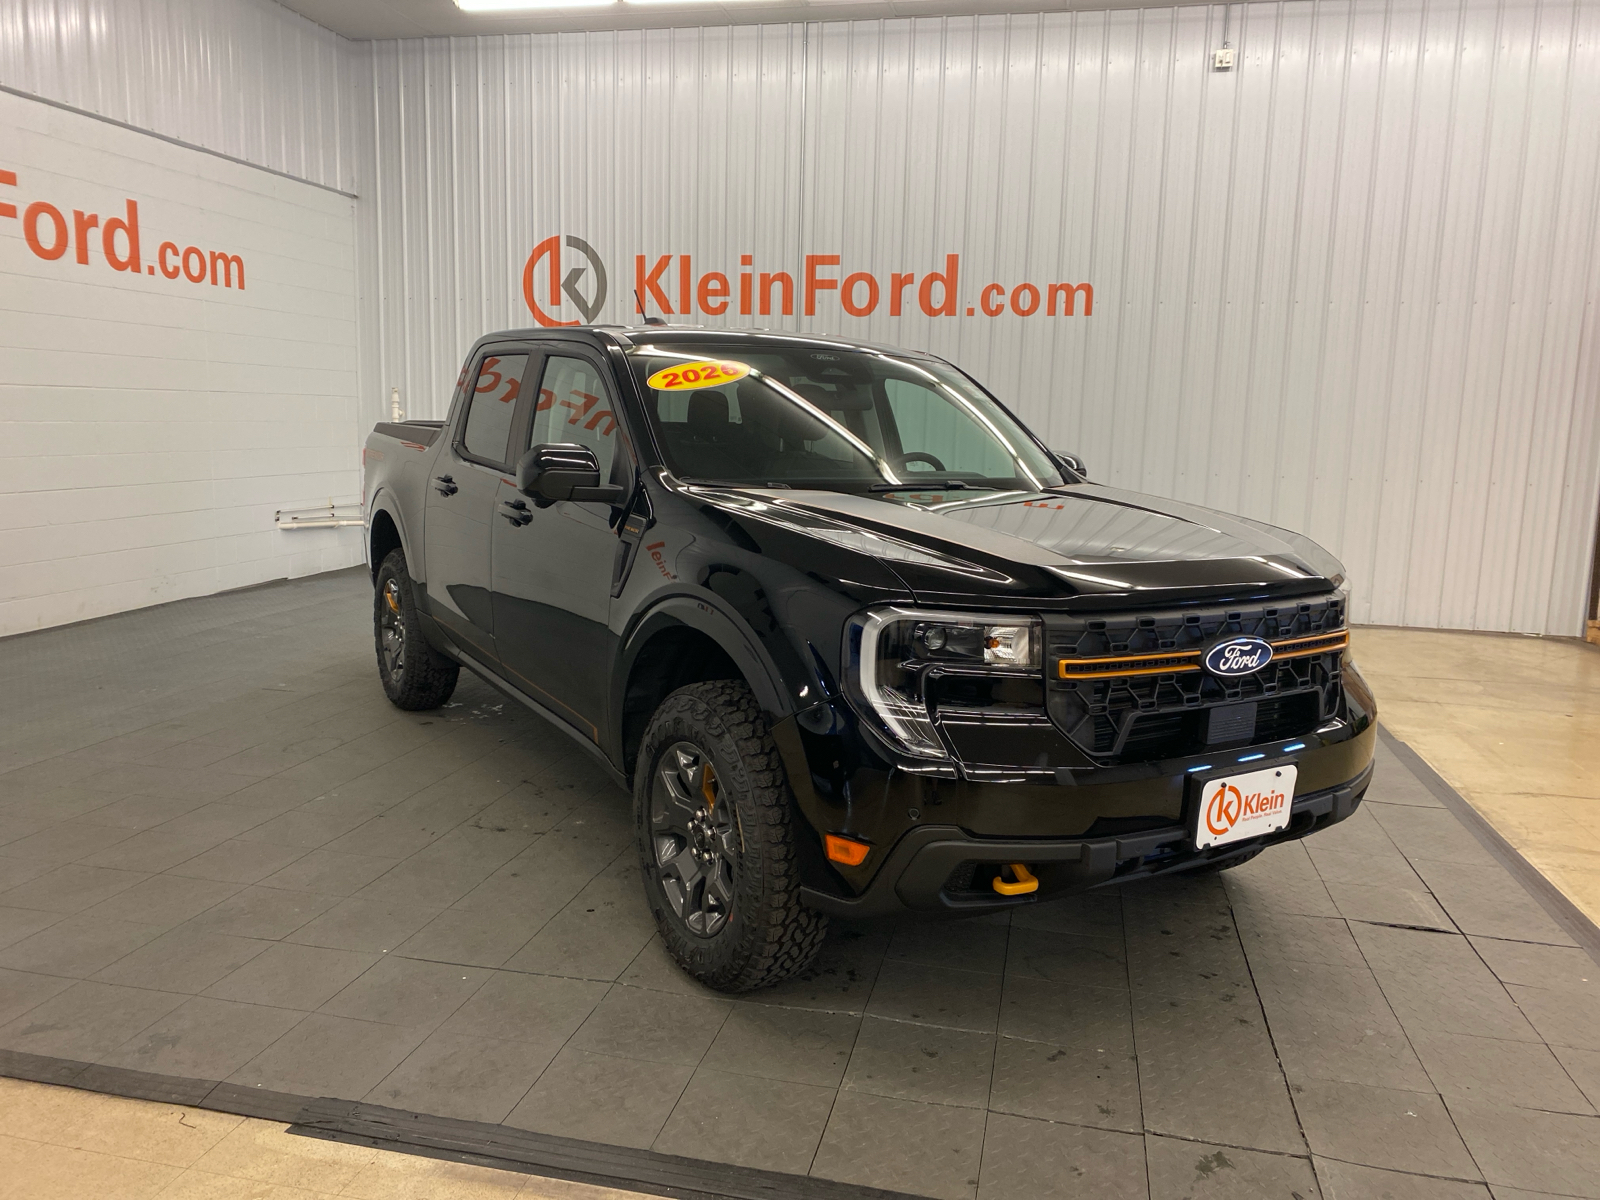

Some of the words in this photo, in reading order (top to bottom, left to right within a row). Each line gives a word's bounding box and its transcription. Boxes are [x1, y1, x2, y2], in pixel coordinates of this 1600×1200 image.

[635, 253, 1095, 318] KleinFord.com
[661, 363, 739, 388] 2026
[1219, 645, 1262, 670] Ford
[1243, 789, 1285, 816] Klein
